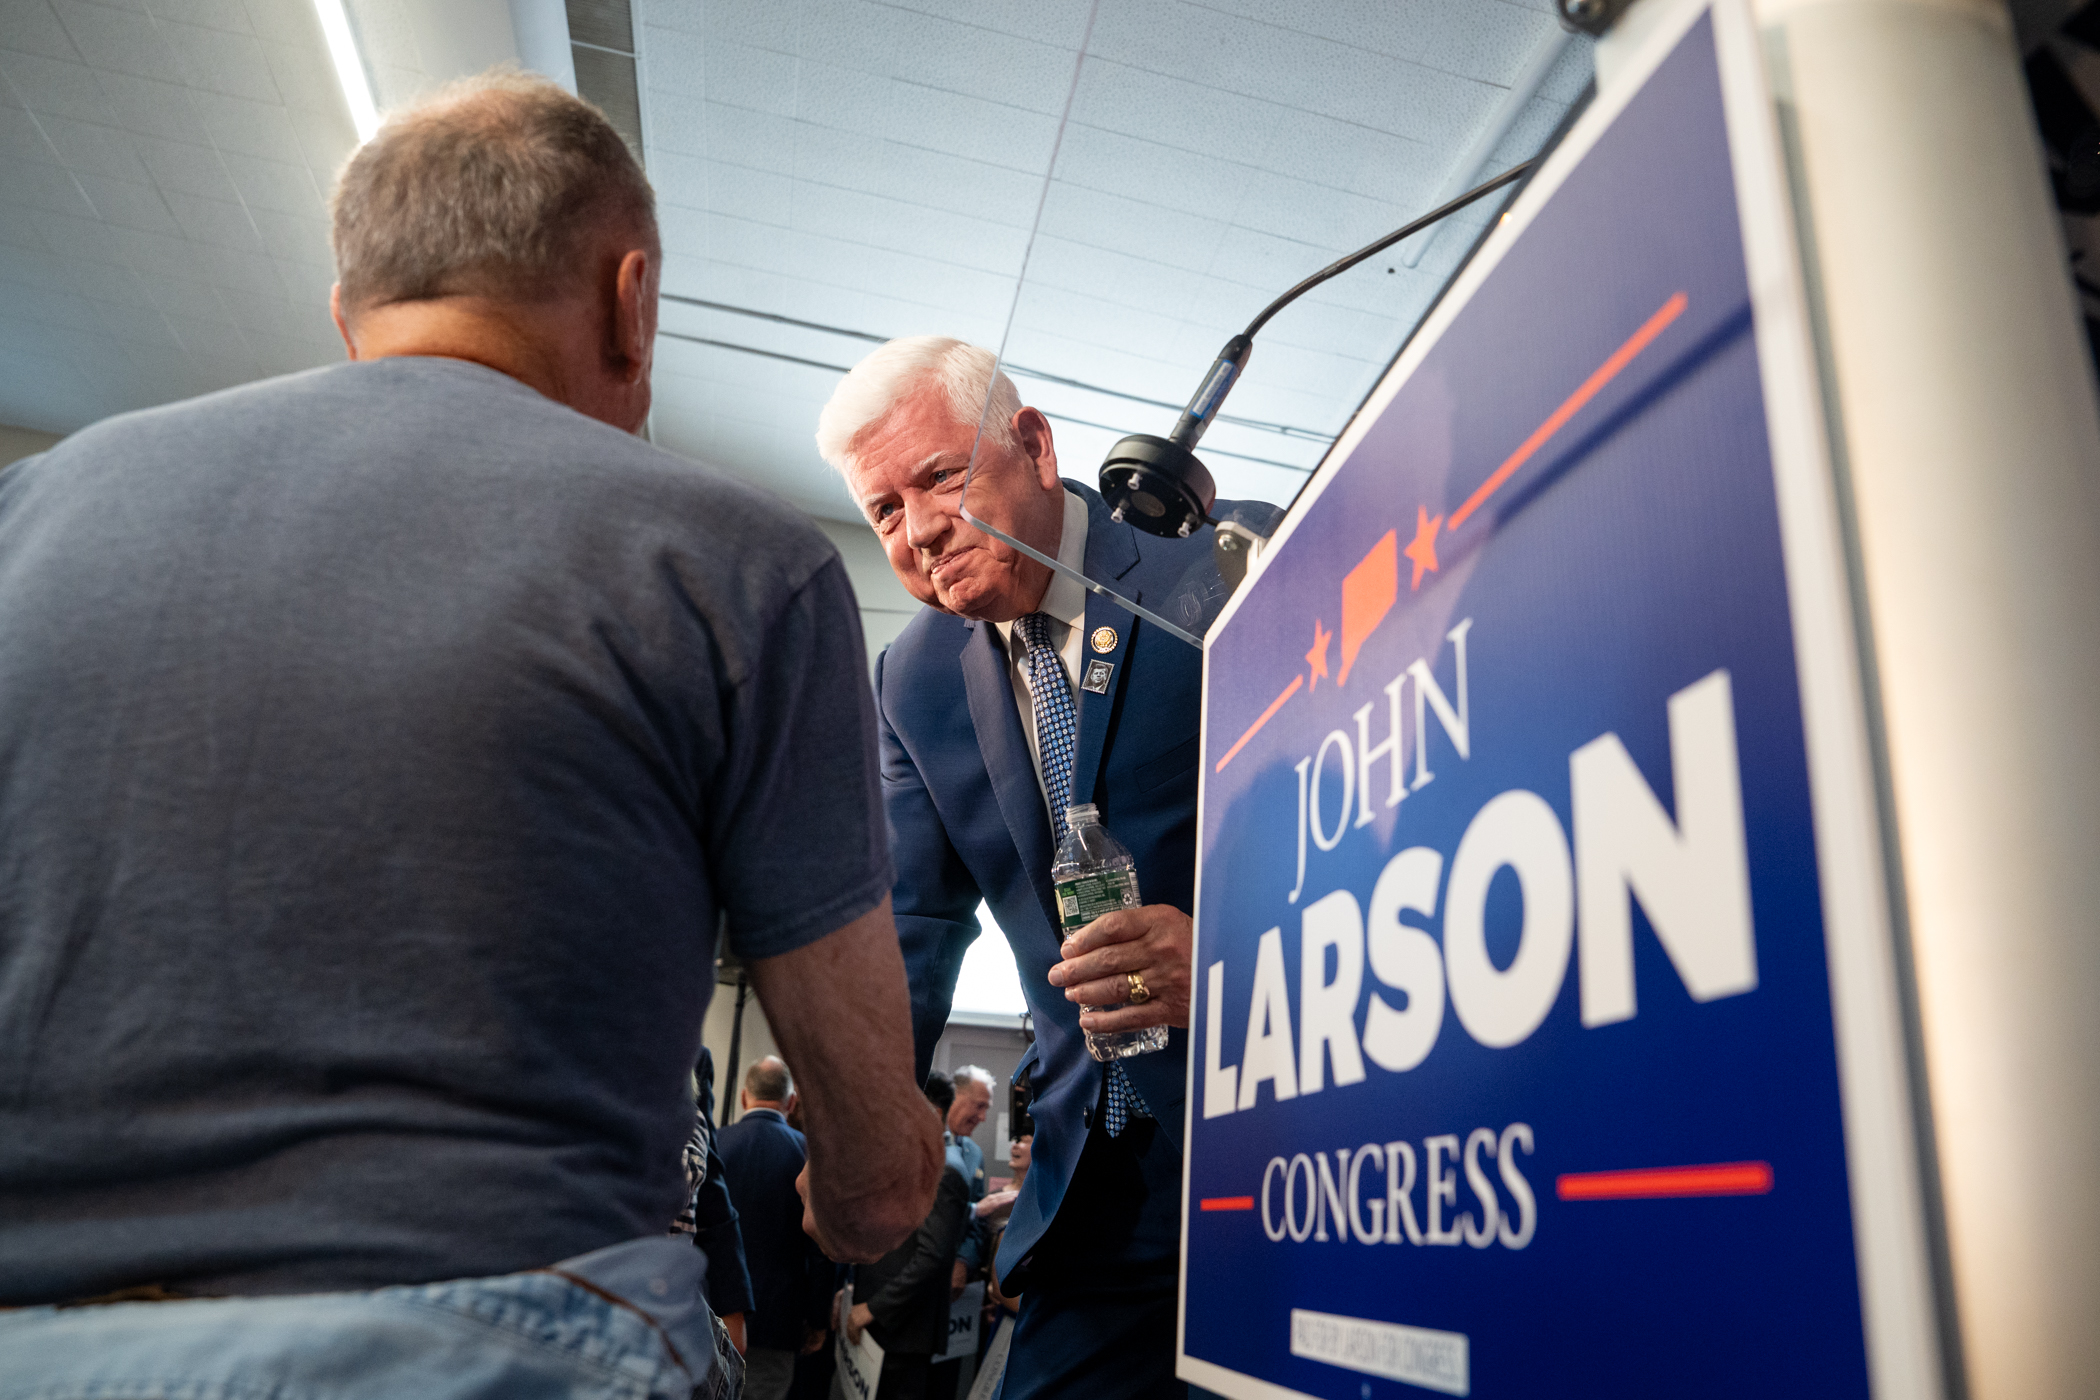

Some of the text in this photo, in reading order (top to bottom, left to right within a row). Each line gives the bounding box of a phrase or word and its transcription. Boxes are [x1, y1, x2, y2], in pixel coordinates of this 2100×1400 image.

[1204, 668, 1758, 1120] LARSON
[1288, 618, 1472, 903] JOHN
[1261, 1122, 1537, 1250] CONGRESS
